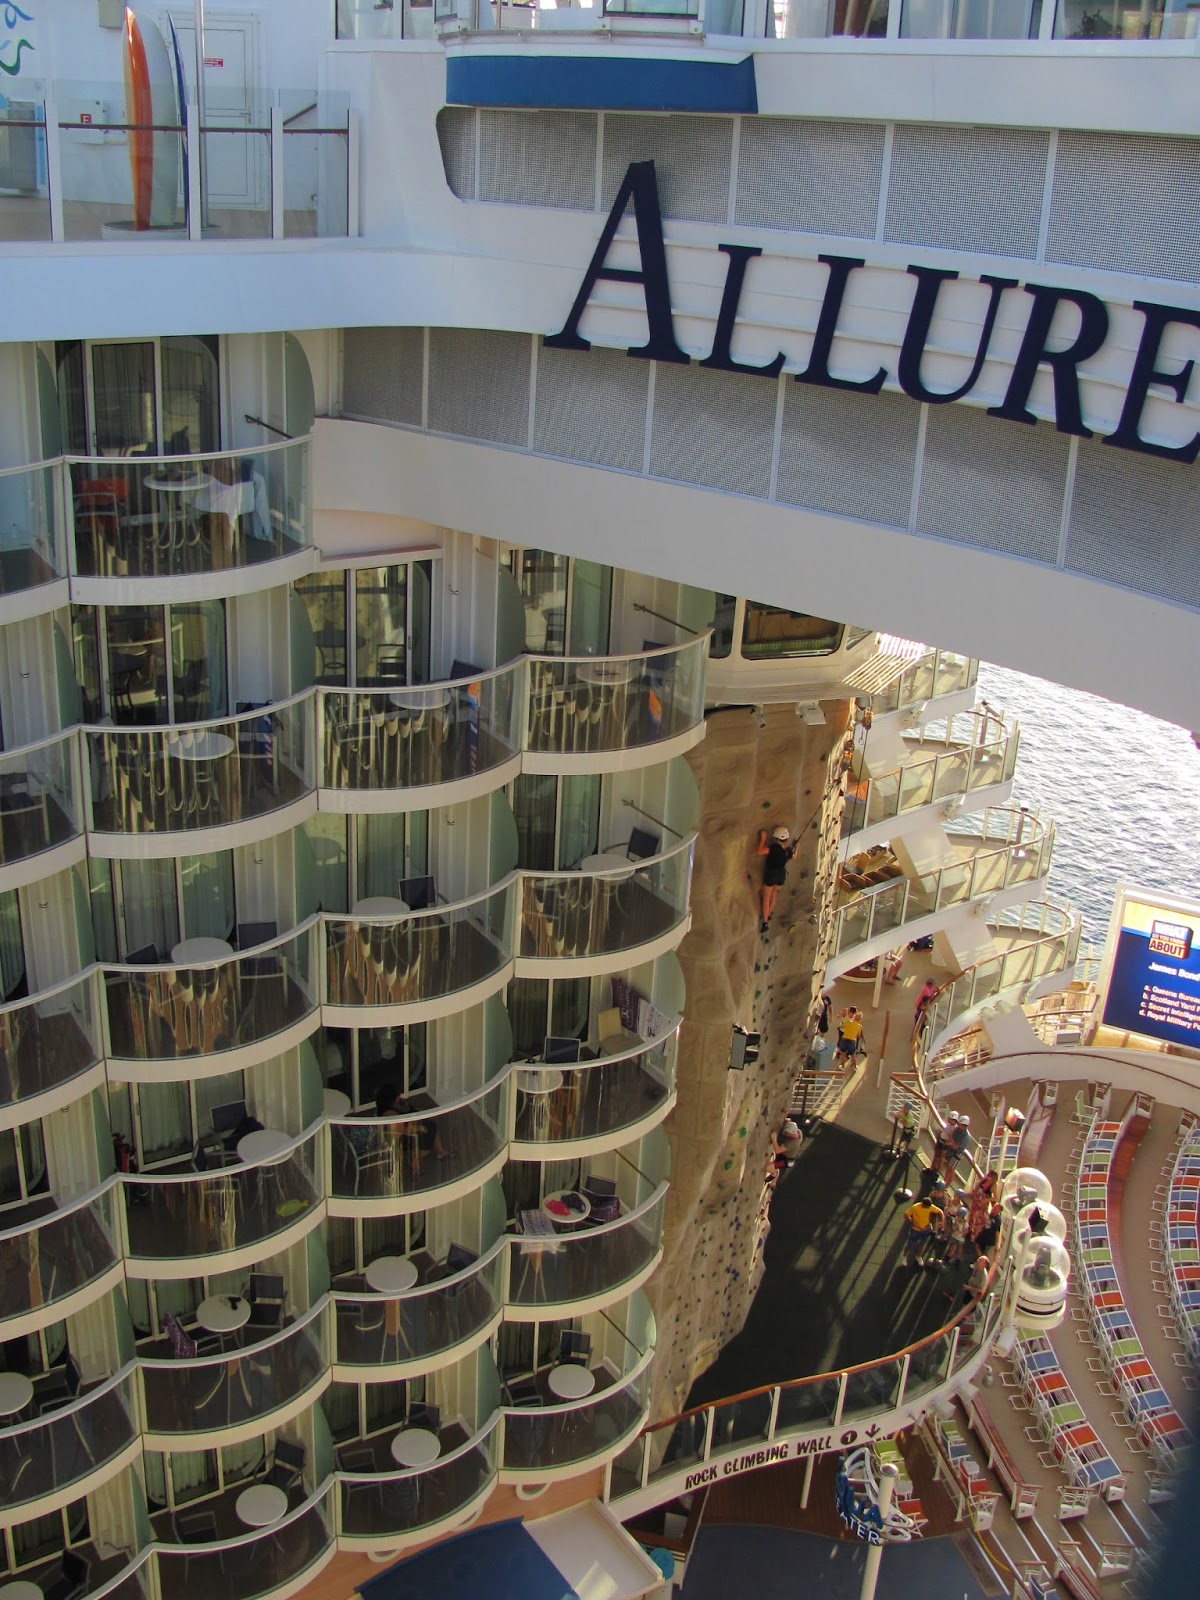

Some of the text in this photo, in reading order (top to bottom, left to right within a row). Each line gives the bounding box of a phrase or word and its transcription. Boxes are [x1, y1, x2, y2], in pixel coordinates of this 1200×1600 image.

[543, 160, 1200, 463] ALLURE
[1150, 939, 1185, 956] ABOUT
[1148, 962, 1177, 976] James
[1152, 985, 1177, 998] Queens
[1148, 1002, 1170, 1014] Secret
[1150, 994, 1180, 1008] Scotland
[1180, 1001, 1196, 1012] Yard
[1147, 1010, 1166, 1022] Royal
[1166, 1015, 1192, 1029] Military
[685, 1466, 718, 1490] ROCK
[723, 1443, 788, 1475] CLIMBING
[797, 1435, 832, 1455] WALL
